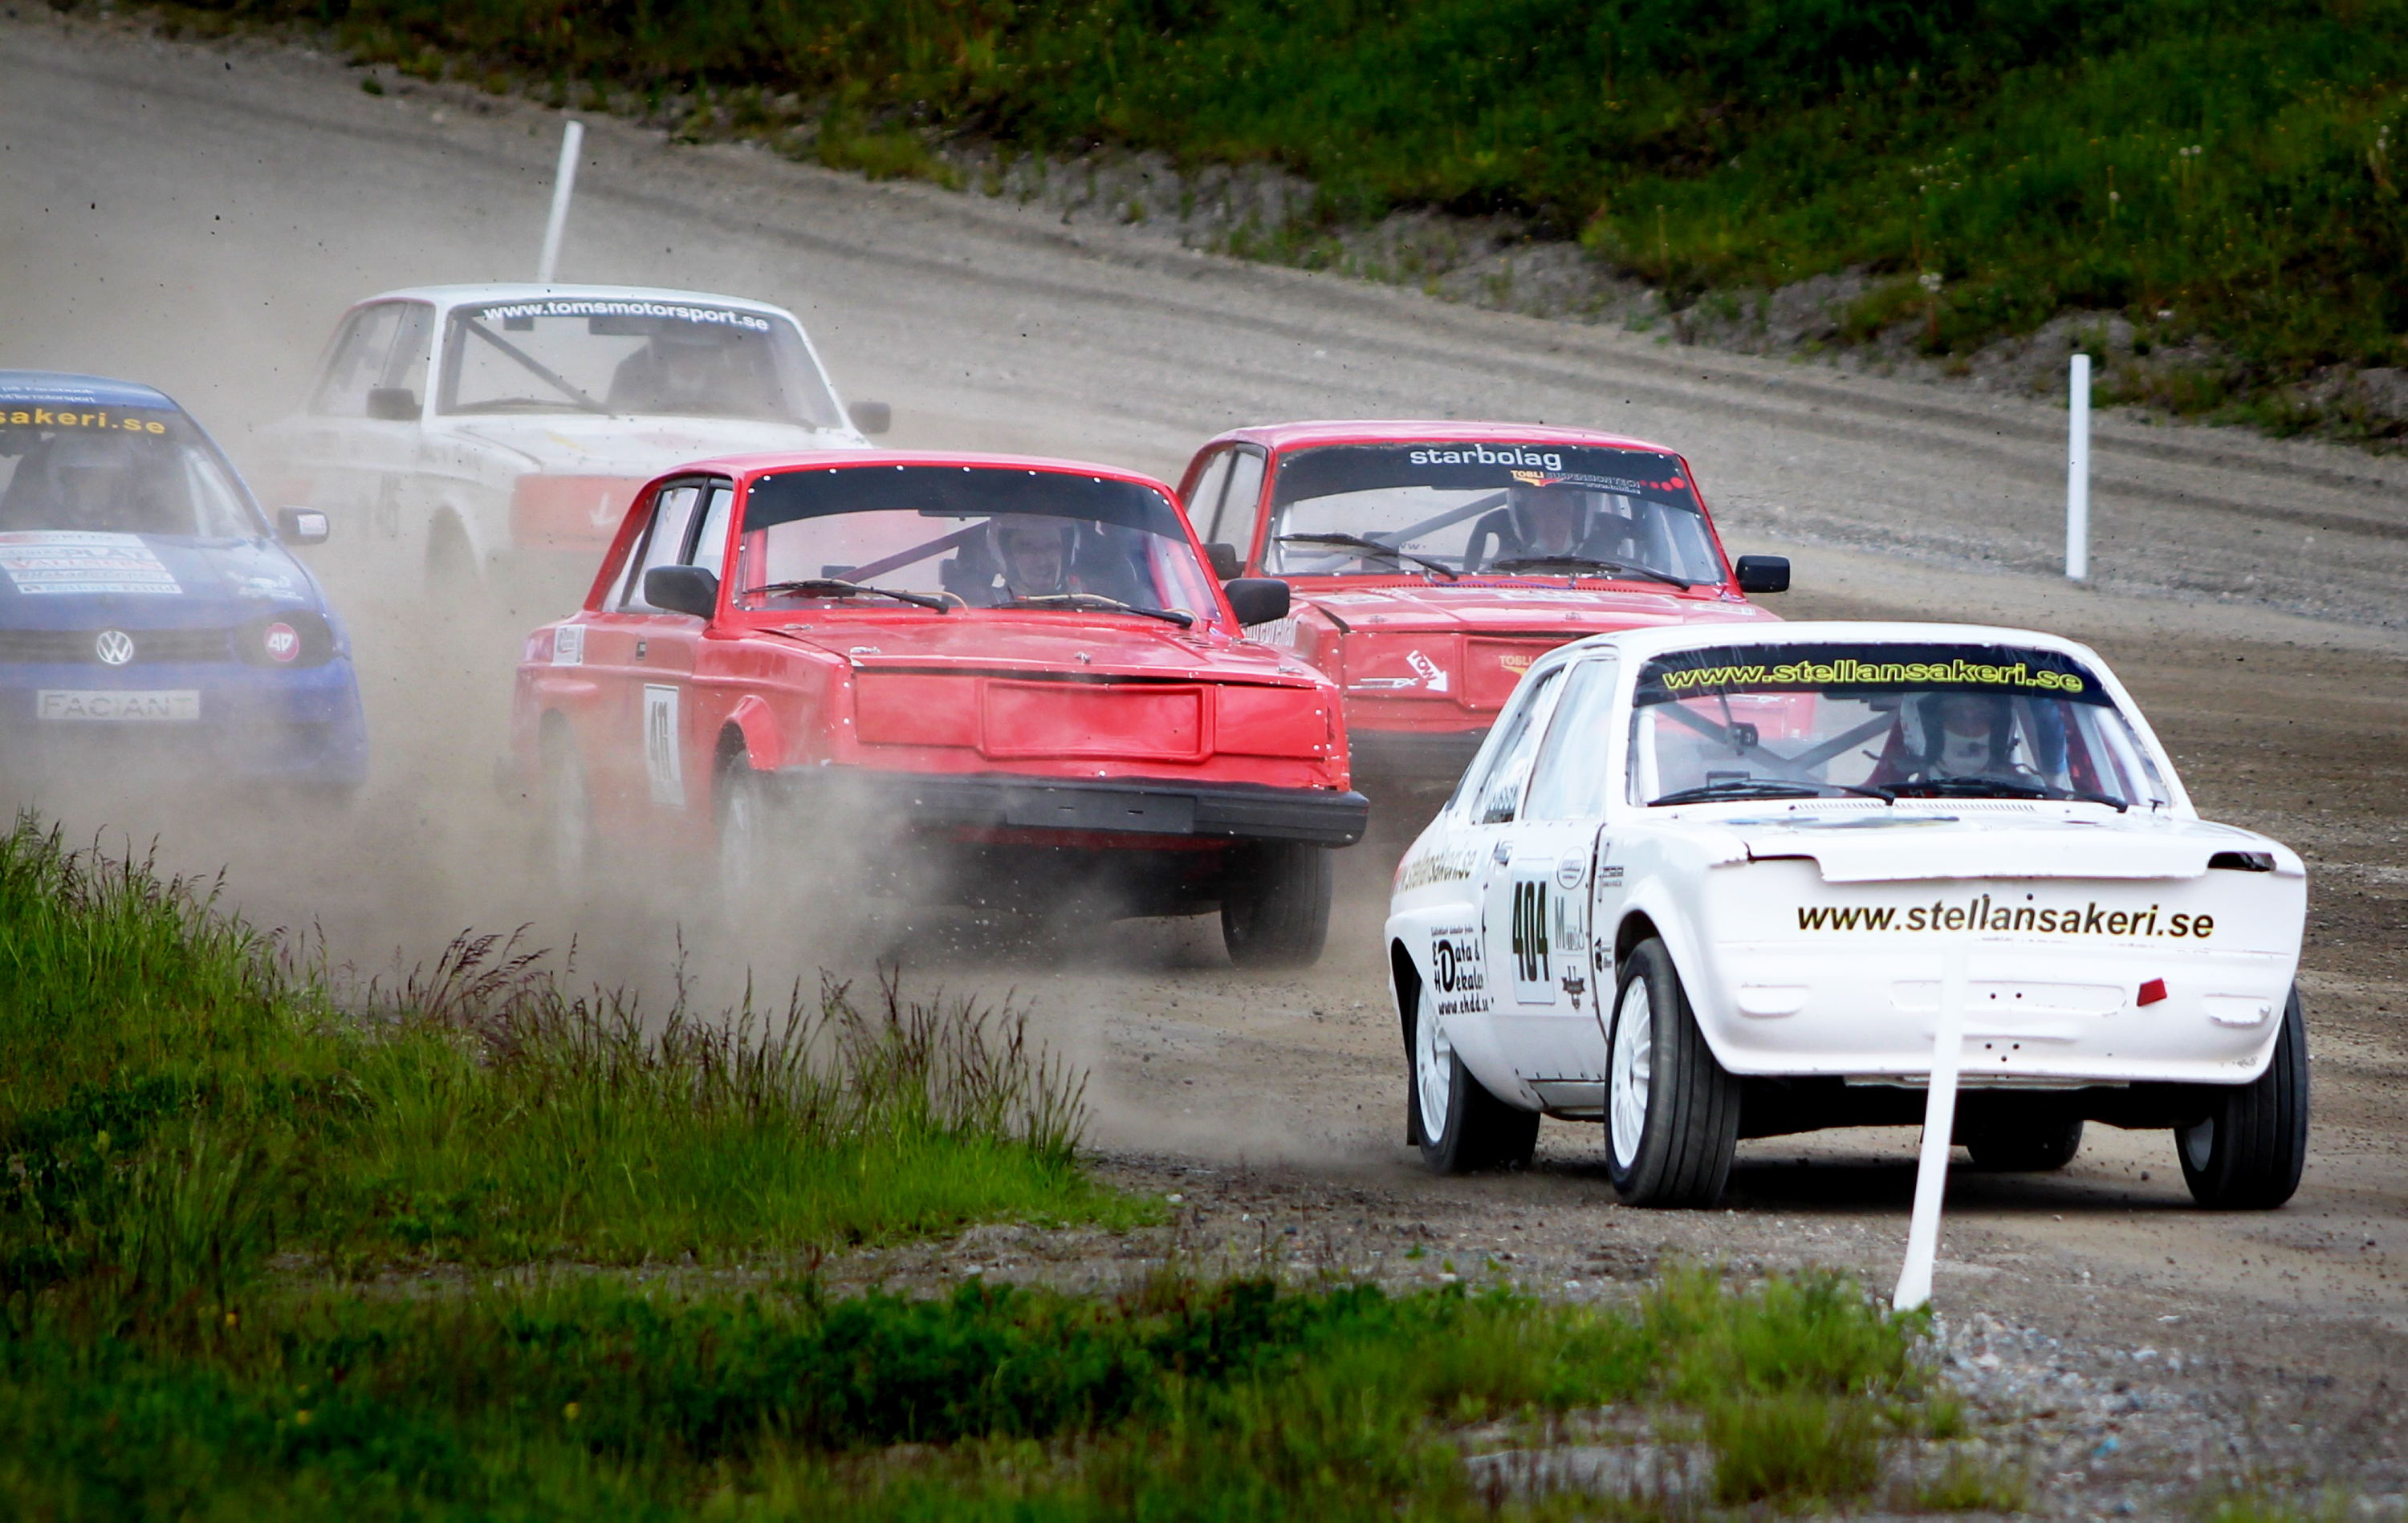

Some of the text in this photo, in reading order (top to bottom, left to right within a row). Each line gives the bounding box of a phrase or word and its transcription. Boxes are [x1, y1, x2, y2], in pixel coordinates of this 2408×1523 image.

[483, 302, 770, 331] www.tomsmotorsport.se
[1410, 447, 1562, 471] starbolag
[1511, 469, 1544, 479] TOBLI
[1662, 660, 2084, 692] www.stellansakeri.se
[1512, 881, 1550, 982] 404
[1797, 898, 2215, 939] www.stellansakeri.se
